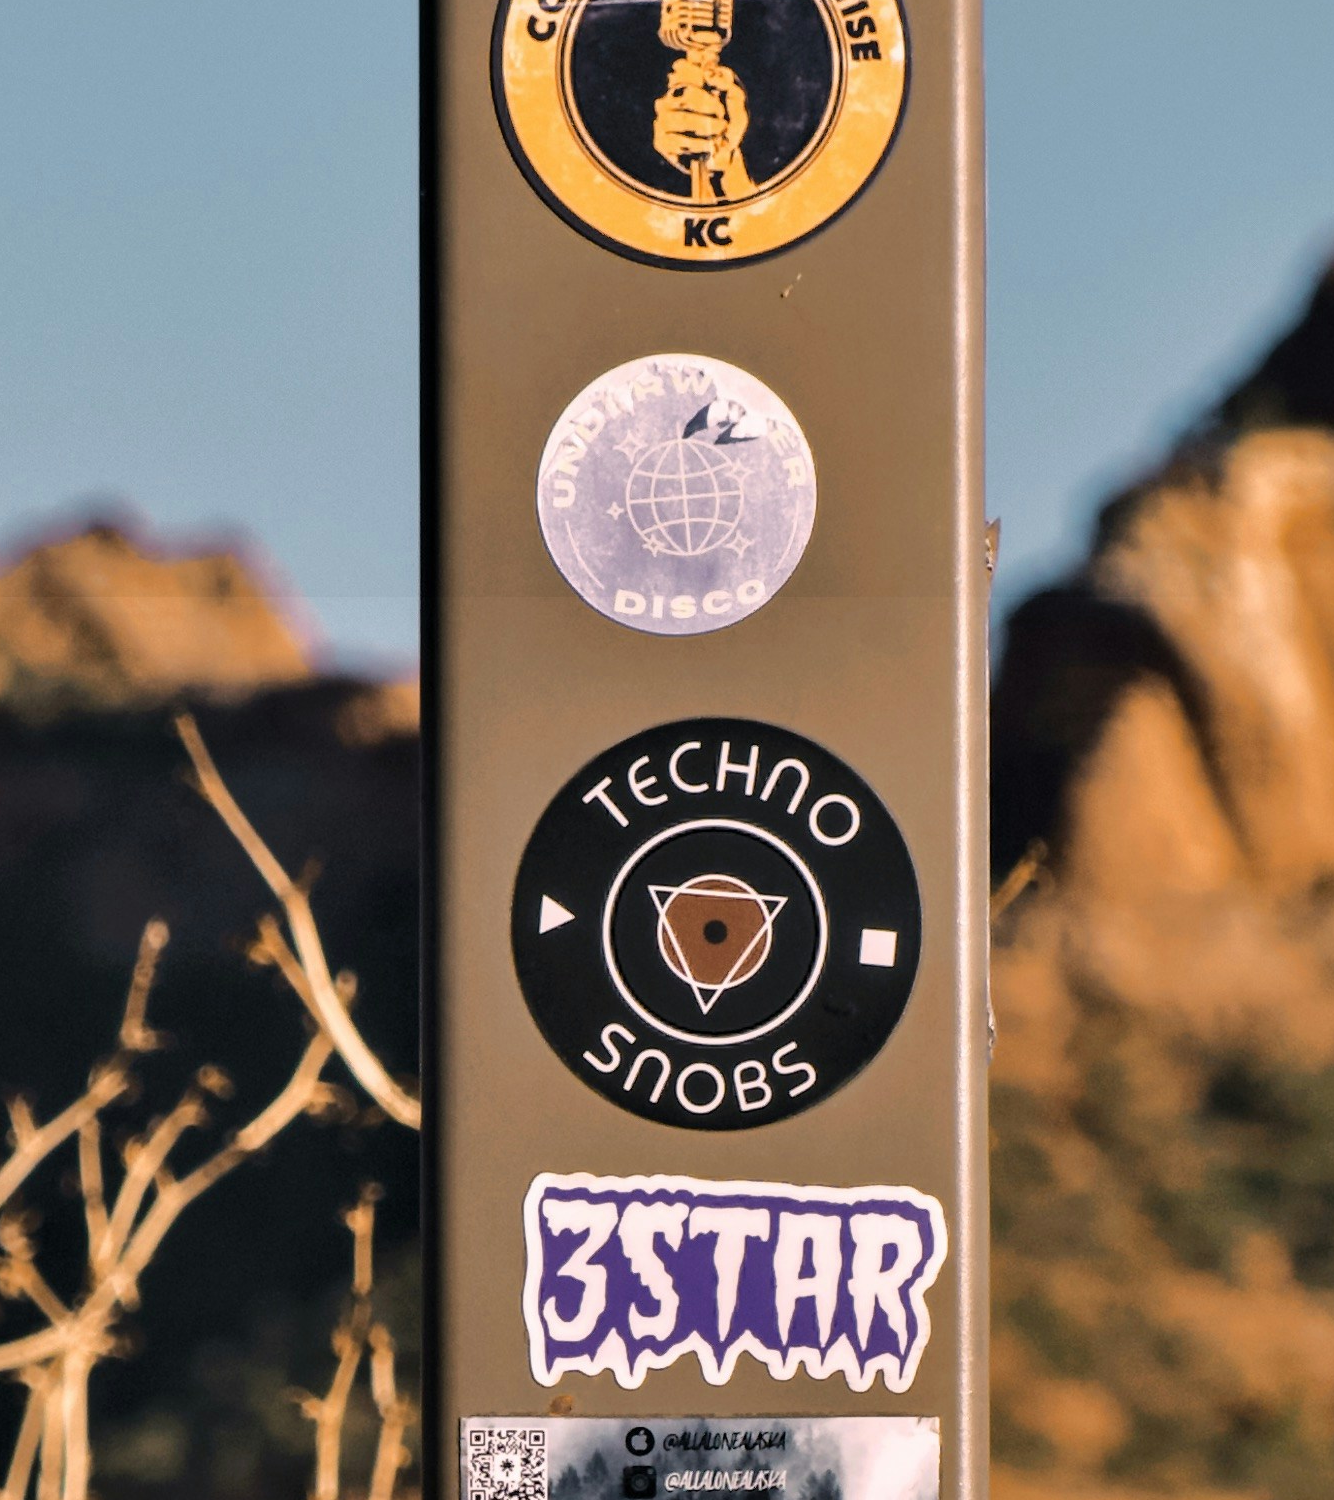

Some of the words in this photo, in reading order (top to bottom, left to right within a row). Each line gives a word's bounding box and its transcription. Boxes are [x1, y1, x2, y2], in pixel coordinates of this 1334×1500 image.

[683, 216, 733, 248] KC
[613, 579, 767, 619] DISCO
[582, 740, 861, 847] TECHNO
[582, 1023, 818, 1114] SNOBS
[540, 1197, 925, 1357] 3STAR
